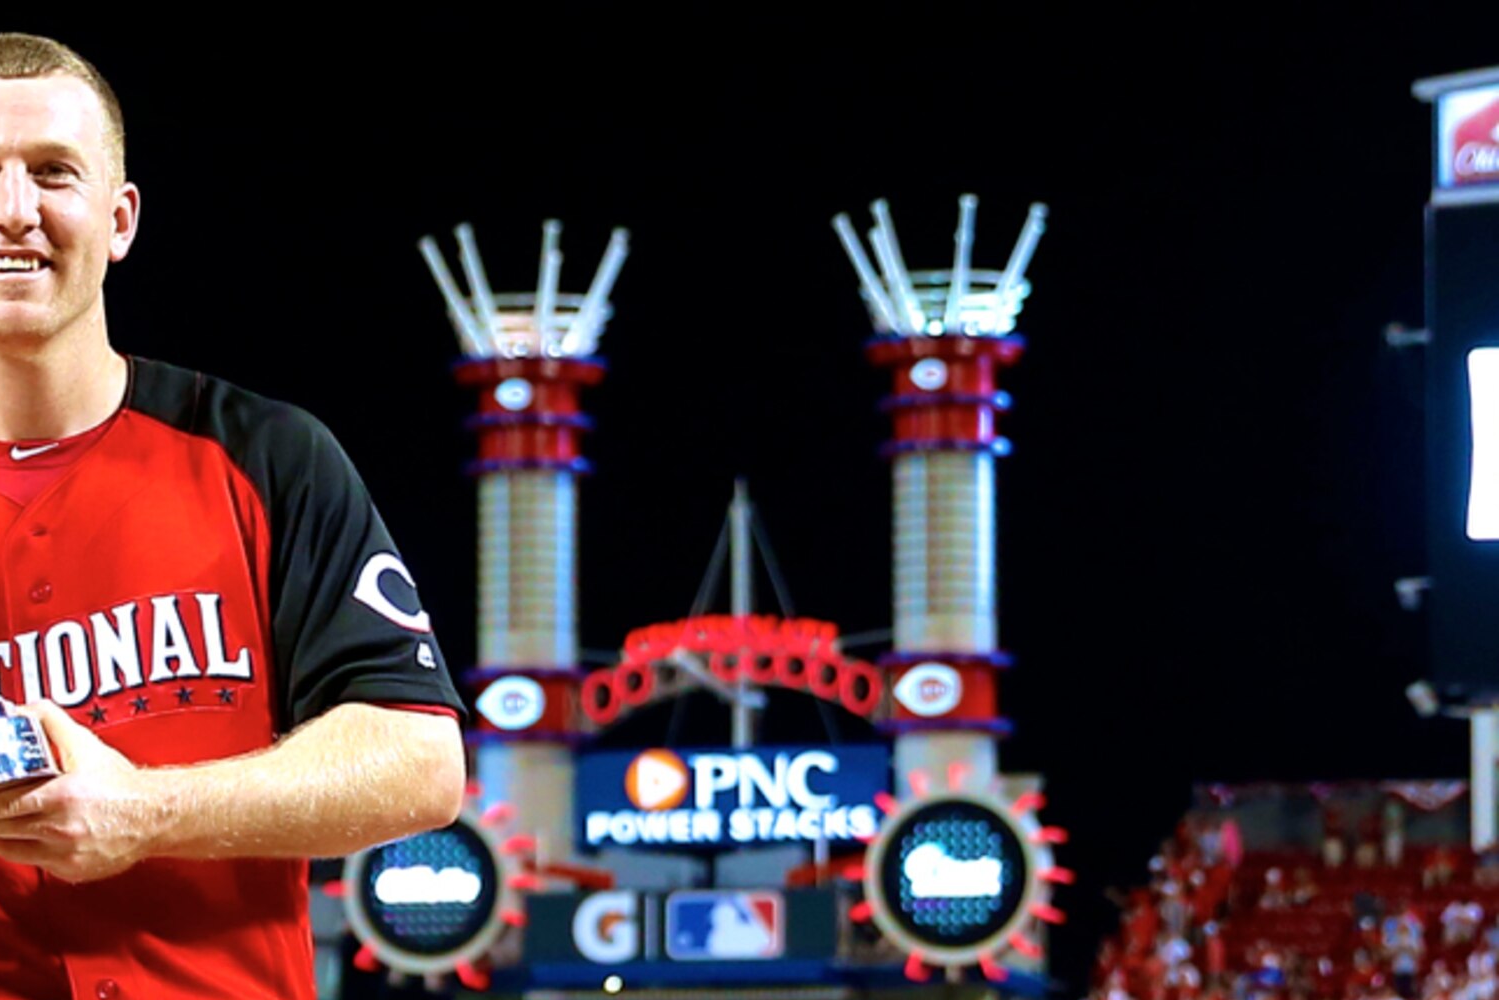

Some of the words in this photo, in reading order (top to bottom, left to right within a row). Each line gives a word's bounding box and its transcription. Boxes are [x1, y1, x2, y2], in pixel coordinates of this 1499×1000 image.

[352, 552, 431, 633] C
[688, 751, 838, 811] PNC
[586, 808, 723, 844] POWER
[729, 803, 879, 843] STACKS
[573, 889, 639, 963] G
